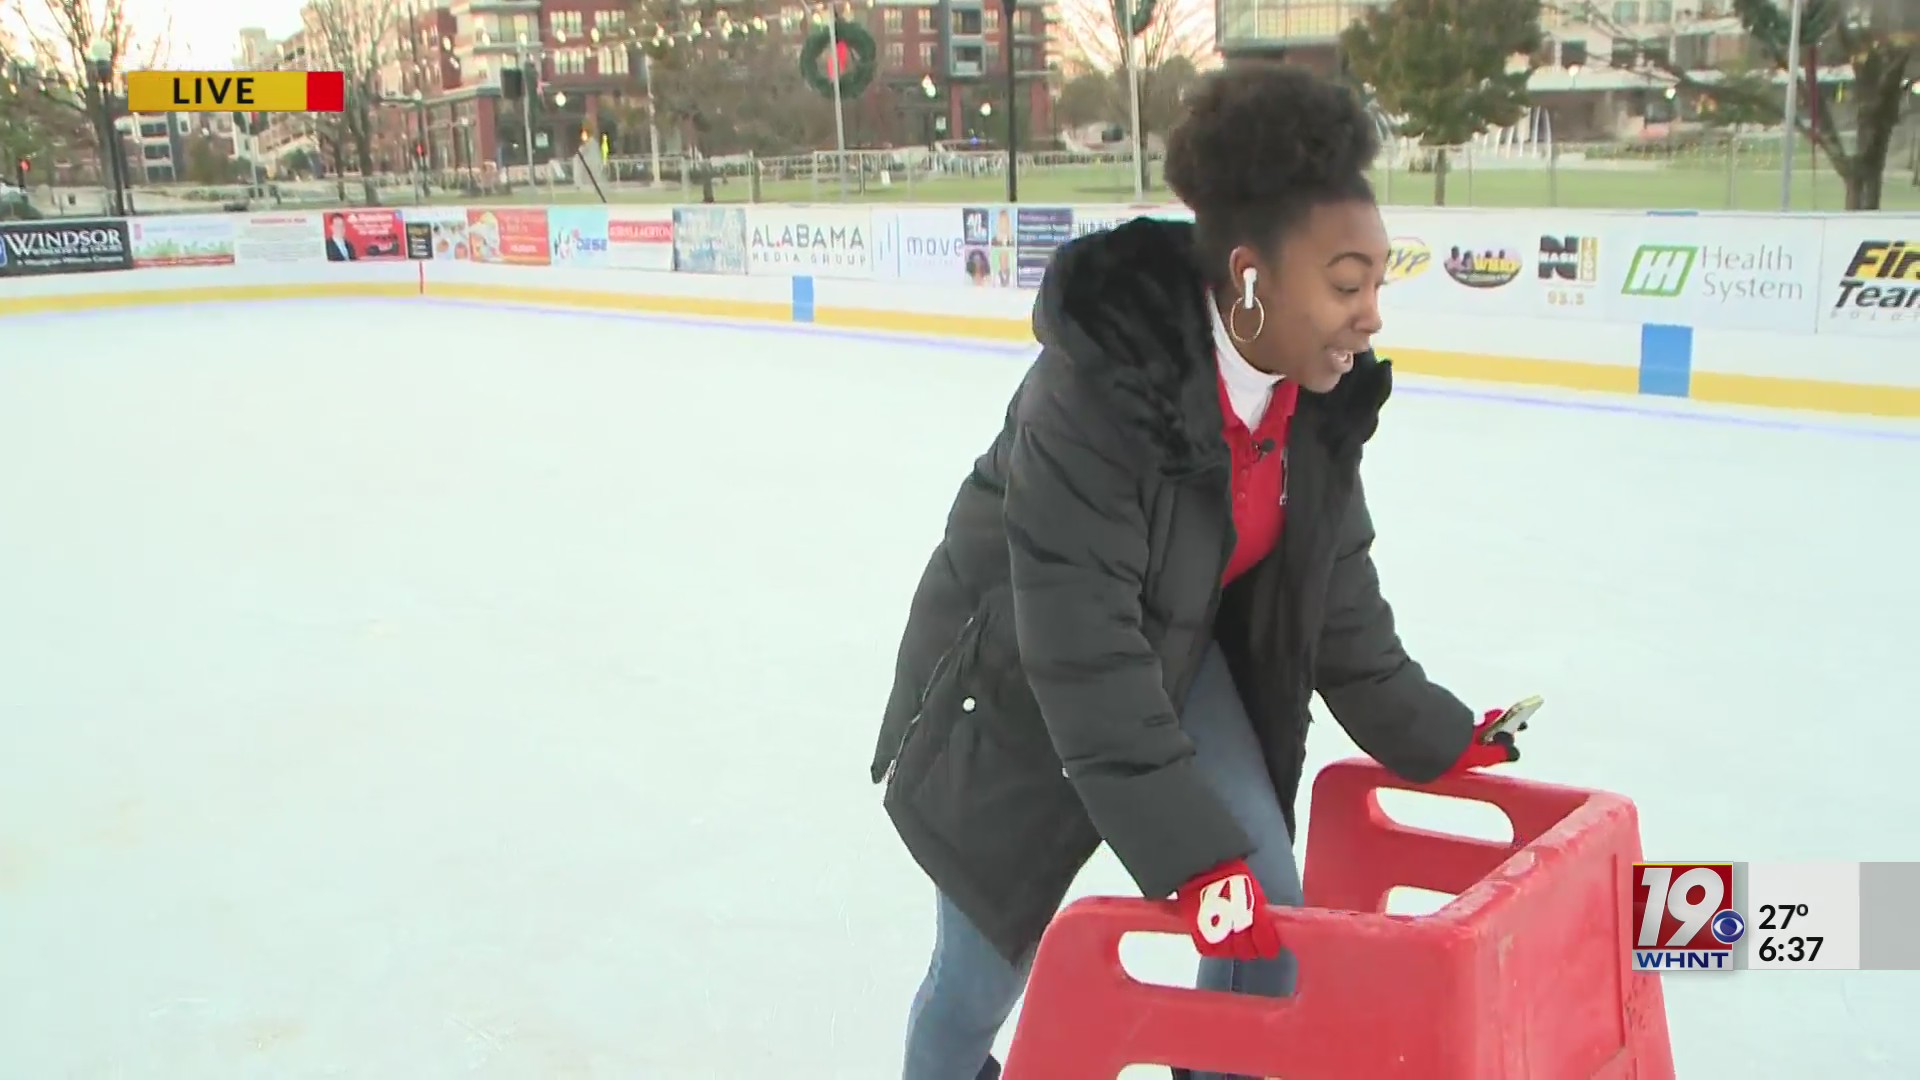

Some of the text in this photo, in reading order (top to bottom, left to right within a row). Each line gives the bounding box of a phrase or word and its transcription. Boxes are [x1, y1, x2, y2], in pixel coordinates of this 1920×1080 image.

[4, 229, 122, 256] WINDSOR
[905, 235, 963, 258] move
[752, 253, 867, 267] MEDIA GROUP
[1702, 244, 1794, 271] Health
[1844, 240, 1920, 279] Fir
[1702, 271, 1803, 303] System
